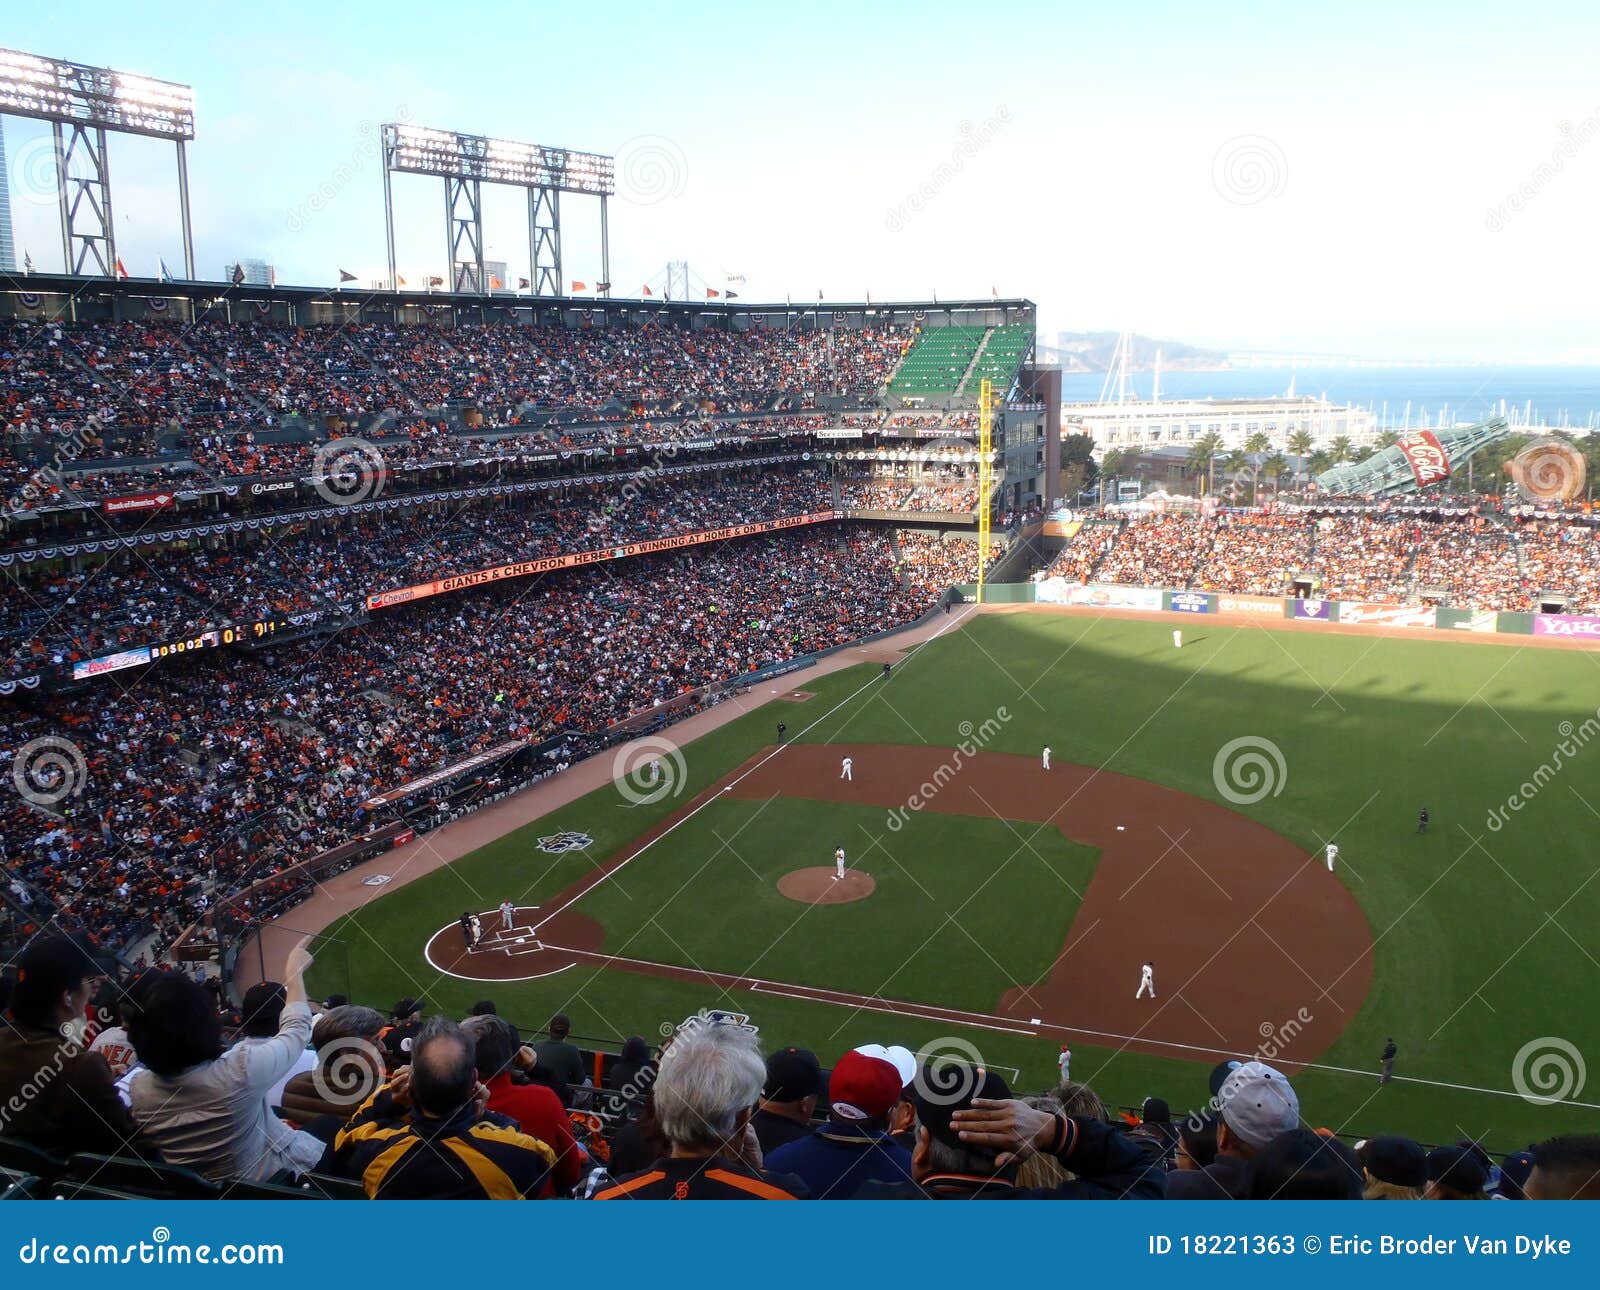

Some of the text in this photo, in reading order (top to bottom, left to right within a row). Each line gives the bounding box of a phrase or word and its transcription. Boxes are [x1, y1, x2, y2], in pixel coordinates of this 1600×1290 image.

[263, 482, 295, 492] LEXUS
[444, 571, 488, 590] GIANTS
[492, 569, 500, 579] &
[504, 557, 566, 576] CHEVRON
[621, 544, 634, 555] TO
[639, 536, 685, 552] WINNING
[688, 534, 701, 543] AT
[704, 529, 731, 541] HOME
[734, 527, 741, 535] &
[744, 524, 756, 534] ON
[759, 521, 776, 531] THE
[779, 517, 802, 528] ROAD
[384, 591, 415, 604] Chevron
